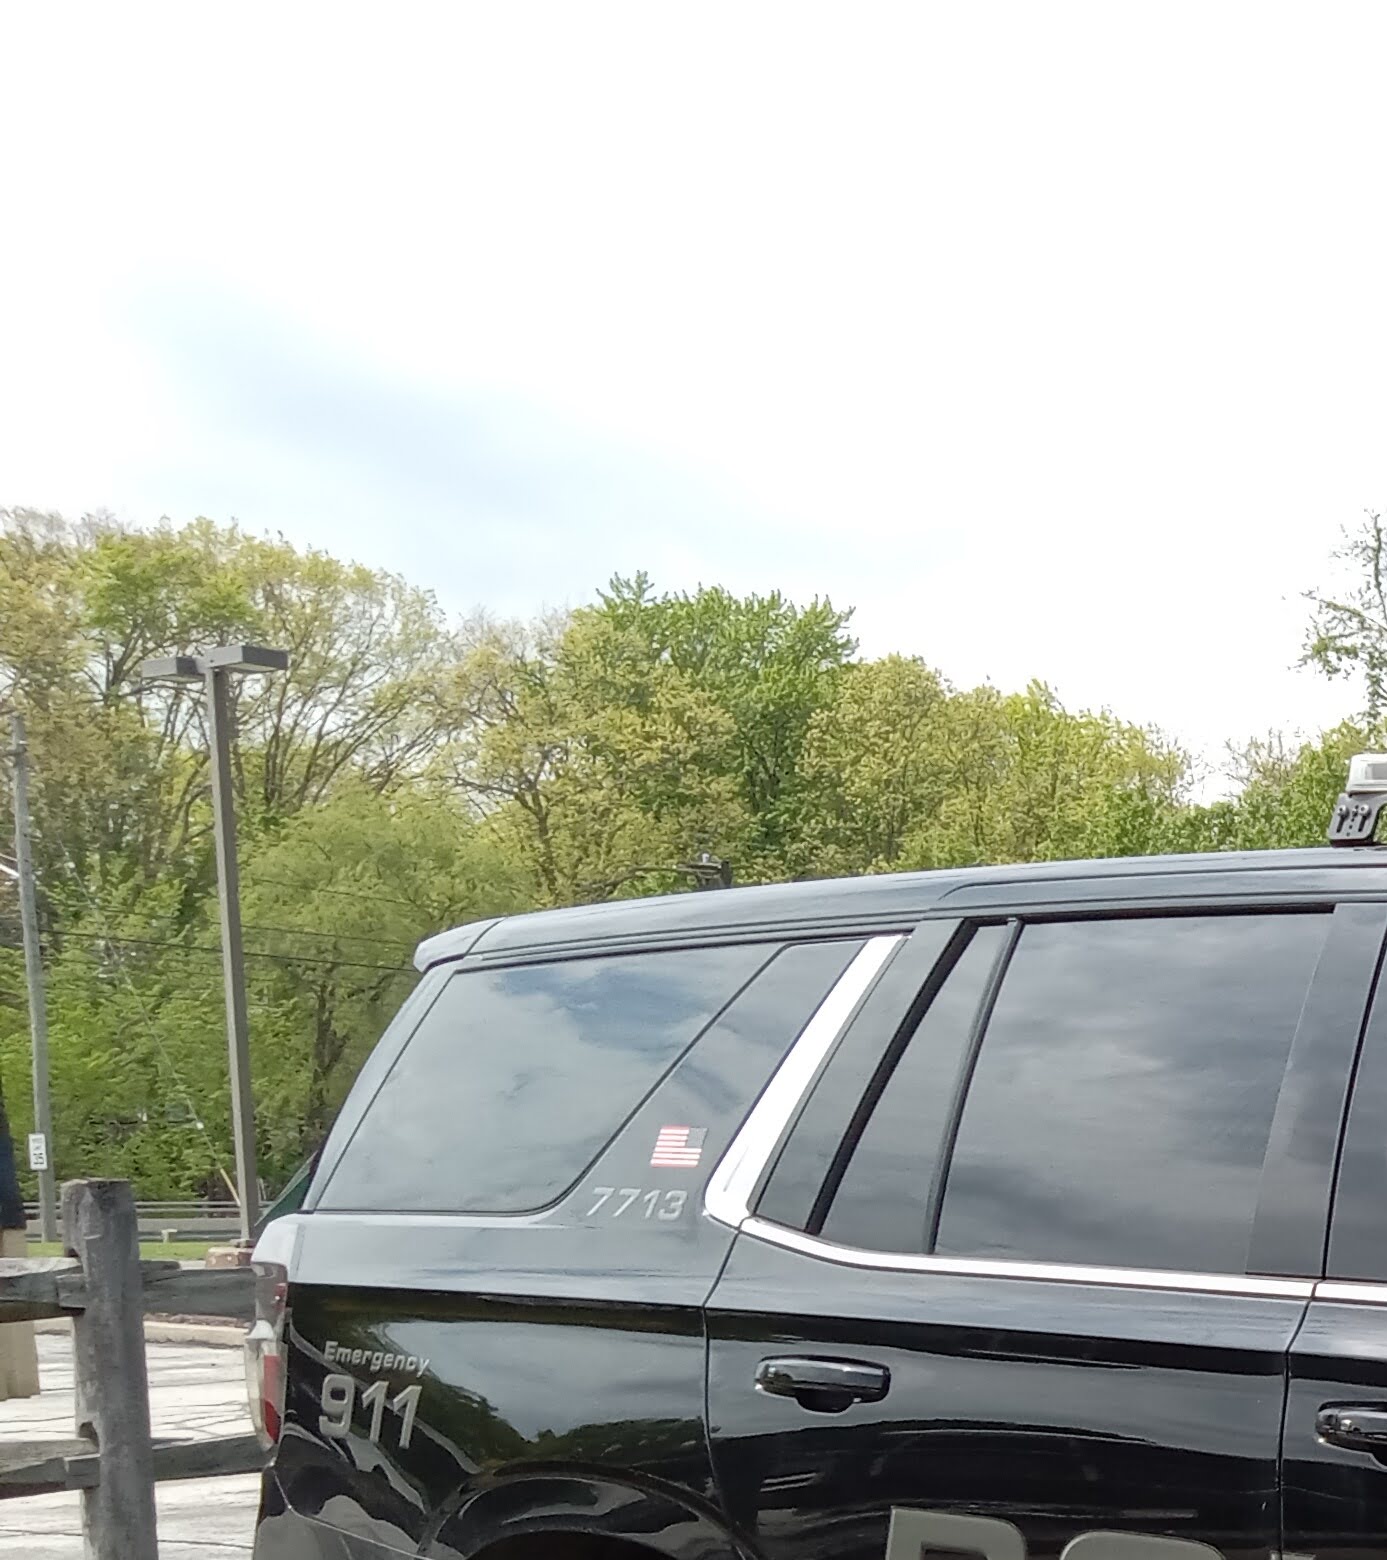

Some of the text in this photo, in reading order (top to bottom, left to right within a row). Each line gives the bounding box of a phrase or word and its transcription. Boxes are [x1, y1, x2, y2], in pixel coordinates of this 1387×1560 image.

[586, 1186, 688, 1221] 7713
[324, 1341, 431, 1379] Emergency
[319, 1374, 422, 1449] 911
